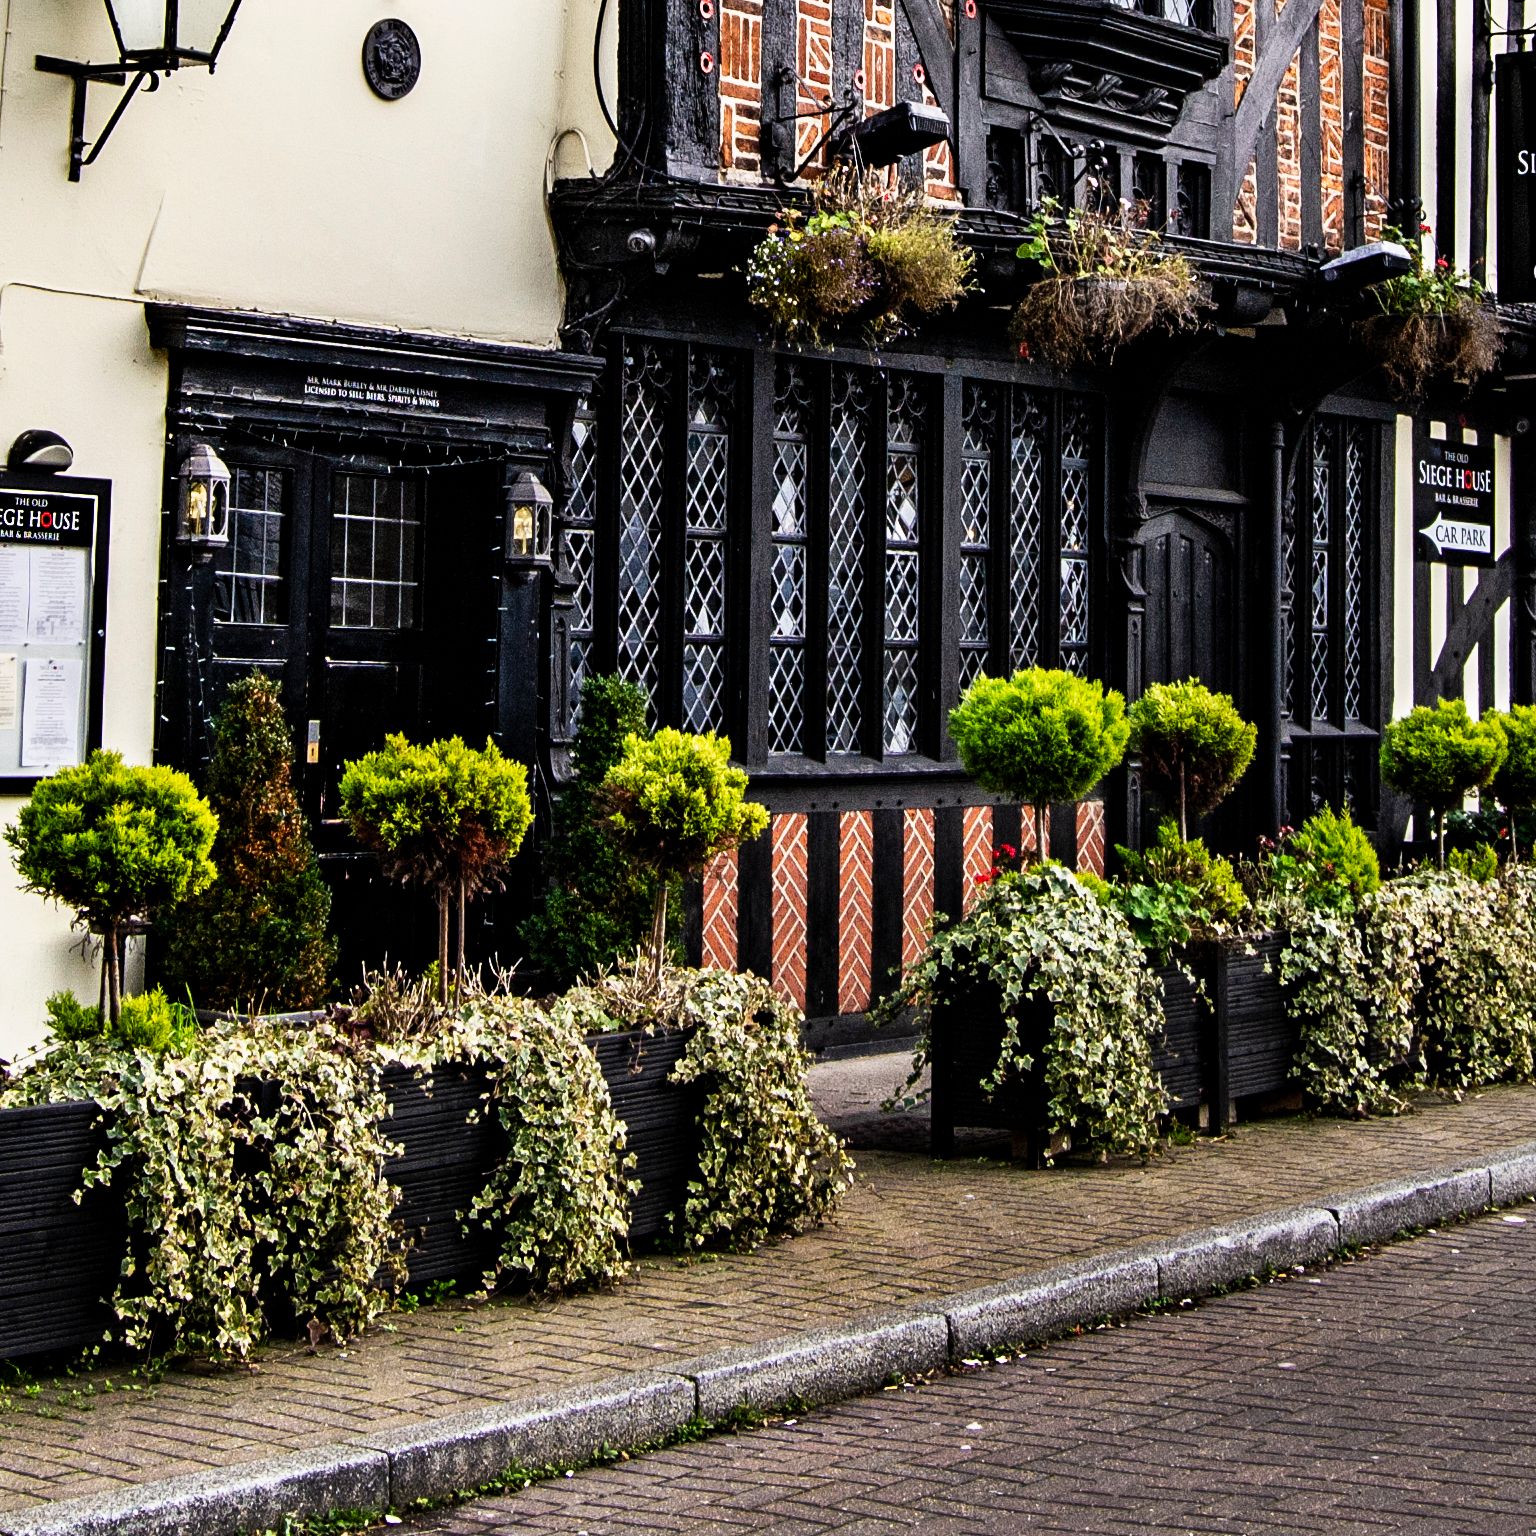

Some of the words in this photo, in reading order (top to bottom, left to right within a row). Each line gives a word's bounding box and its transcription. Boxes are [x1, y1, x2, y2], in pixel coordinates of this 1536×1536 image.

[304, 384, 337, 396] LICENSED
[338, 388, 348, 397] TO
[388, 394, 411, 404] SPIRITS
[419, 397, 440, 407] WINES
[1445, 451, 1455, 462] THE
[1456, 453, 1469, 464] OLD
[1419, 459, 1453, 487] SIEGE
[1455, 468, 1492, 493] HOUSE
[15, 497, 30, 506] THE
[31, 498, 48, 507] OLD
[1435, 492, 1446, 503] BAR
[29, 510, 80, 530] HOUSE
[0, 529, 14, 538] BAR
[15, 530, 21, 539] &
[24, 531, 60, 541] BRASSERIE
[1435, 524, 1458, 544] CAR
[1461, 527, 1486, 547] PARK
